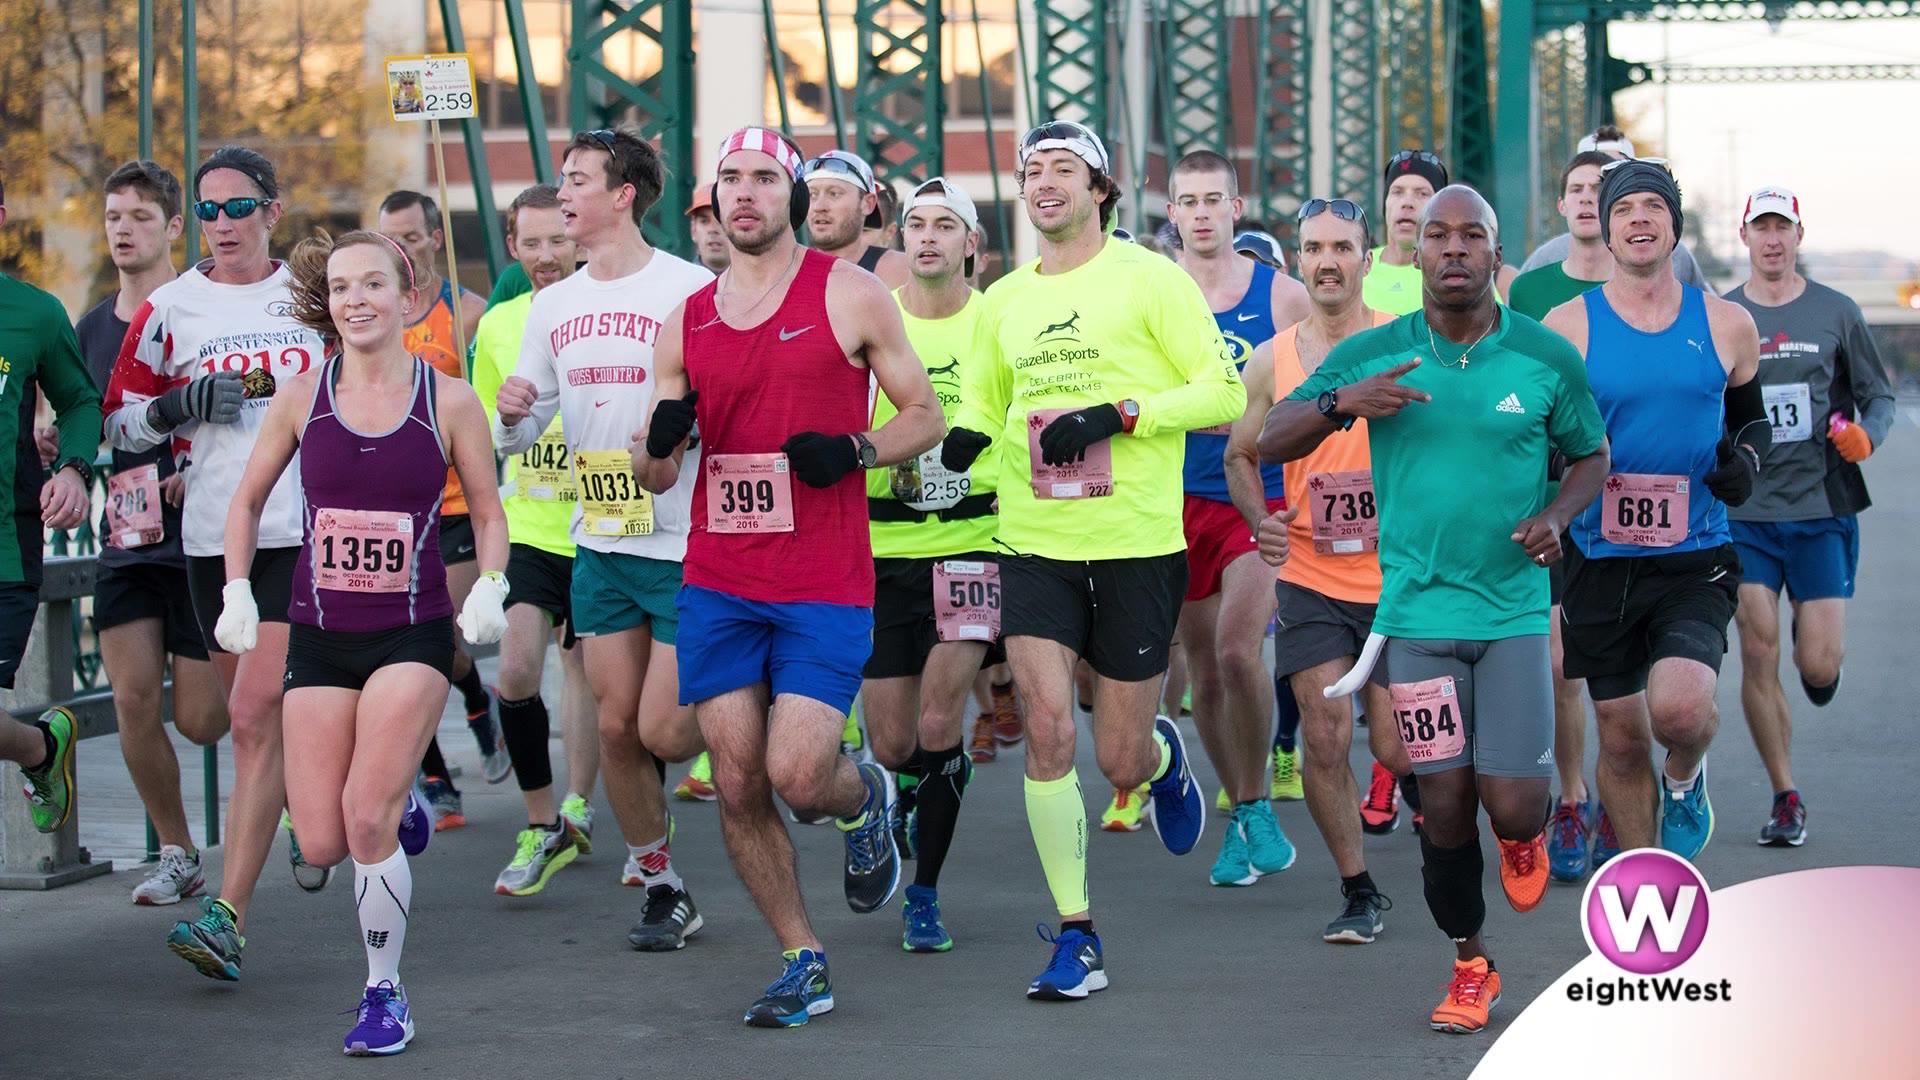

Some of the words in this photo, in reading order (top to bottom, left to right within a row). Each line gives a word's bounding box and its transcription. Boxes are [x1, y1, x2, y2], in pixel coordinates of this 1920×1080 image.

[425, 92, 472, 111] 2:59
[550, 313, 594, 358] OHIO
[199, 333, 308, 359] BICENTENNIAL
[1778, 341, 1819, 354] MARATHON
[1015, 350, 1058, 370] Gazelle
[1059, 348, 1100, 365] Sports
[593, 366, 640, 383] COUNTRY
[1029, 371, 1094, 387] CELEBRITY
[1055, 382, 1102, 394] TEAMS
[936, 391, 963, 407] Spo
[1495, 404, 1526, 414] adidas
[539, 475, 560, 483] 2016
[1056, 470, 1079, 478] 2016
[580, 472, 644, 502] 10331
[924, 477, 971, 502] 2:59
[1088, 485, 1109, 497] 227
[720, 479, 774, 514] 399
[605, 508, 624, 516] 2016
[1322, 490, 1376, 523] 738
[1617, 496, 1672, 529] 681
[624, 522, 651, 535] 10331
[736, 520, 759, 529] 2016
[1341, 527, 1363, 535] 2016
[1633, 534, 1656, 542] 2016
[322, 535, 405, 573] 1359
[347, 579, 374, 589] 2016
[949, 580, 1000, 611] 505
[966, 613, 988, 621] 2016
[1410, 748, 1433, 759] 2016
